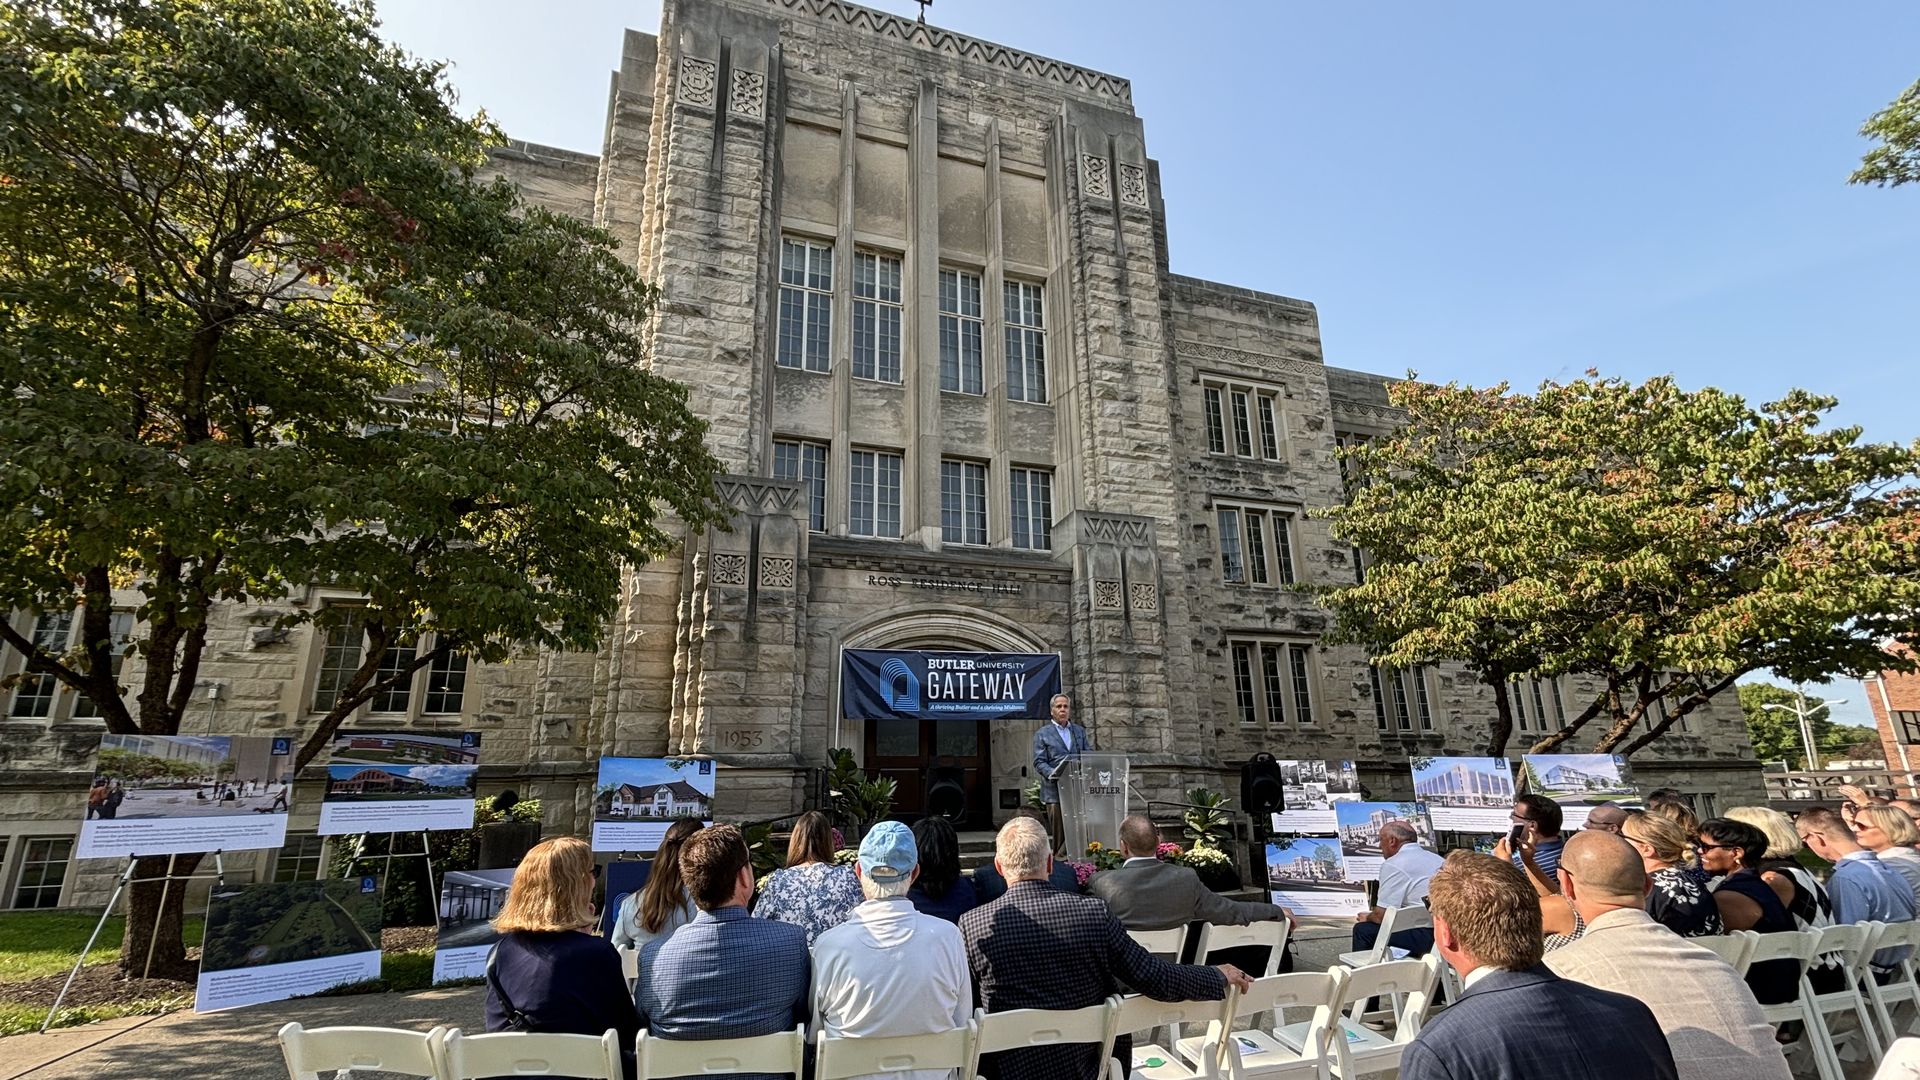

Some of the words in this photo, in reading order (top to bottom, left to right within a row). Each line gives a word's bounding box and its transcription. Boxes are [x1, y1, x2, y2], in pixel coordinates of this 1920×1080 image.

[868, 575, 902, 588] ROSS
[911, 578, 984, 594] RESIDENCE
[927, 658, 976, 670] BUTLER
[976, 661, 1025, 670] UNIVERSITY
[927, 671, 1026, 700] GATEWAY
[725, 730, 763, 747] 1953
[1089, 786, 1121, 795] BUTLER
